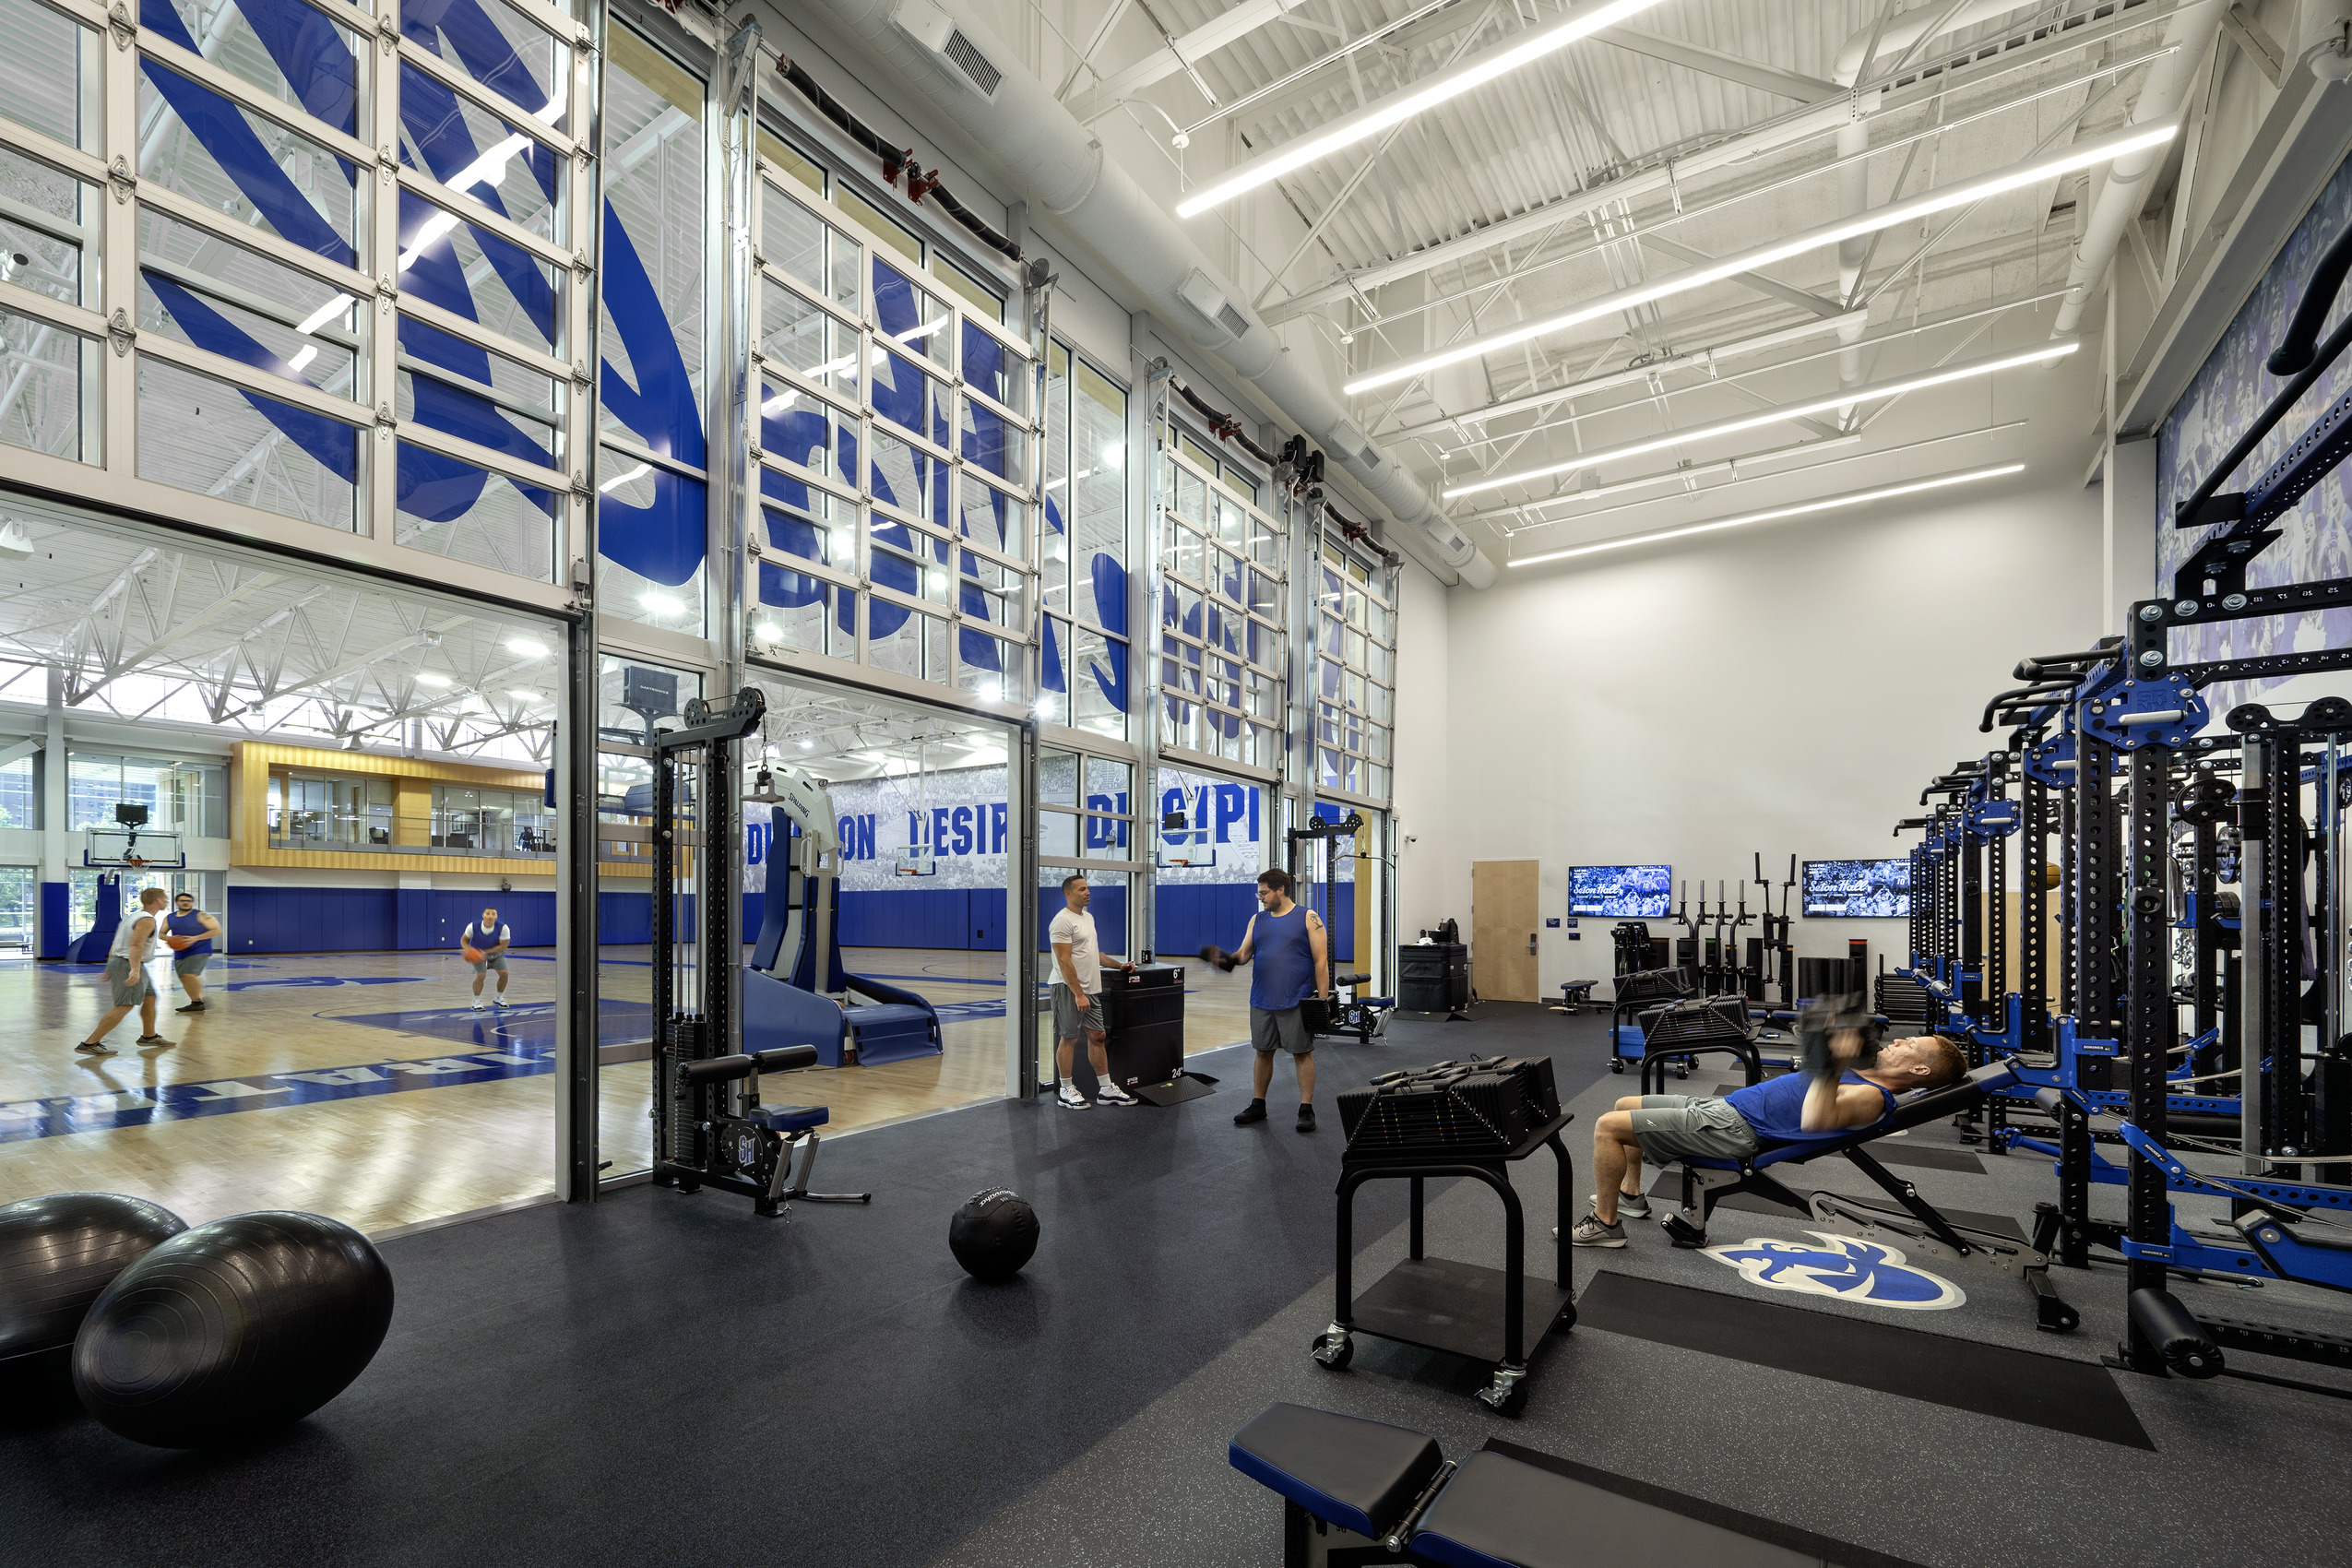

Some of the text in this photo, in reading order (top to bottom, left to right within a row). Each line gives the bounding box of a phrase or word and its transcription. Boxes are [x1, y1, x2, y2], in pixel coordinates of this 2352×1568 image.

[788, 792, 810, 818] SPALDING
[908, 802, 1007, 858] DESIR
[1574, 883, 1621, 895] Seton Hall
[1809, 879, 1870, 892] Seton Hall
[1348, 1010, 1360, 1024] SH
[738, 1134, 755, 1168] SH
